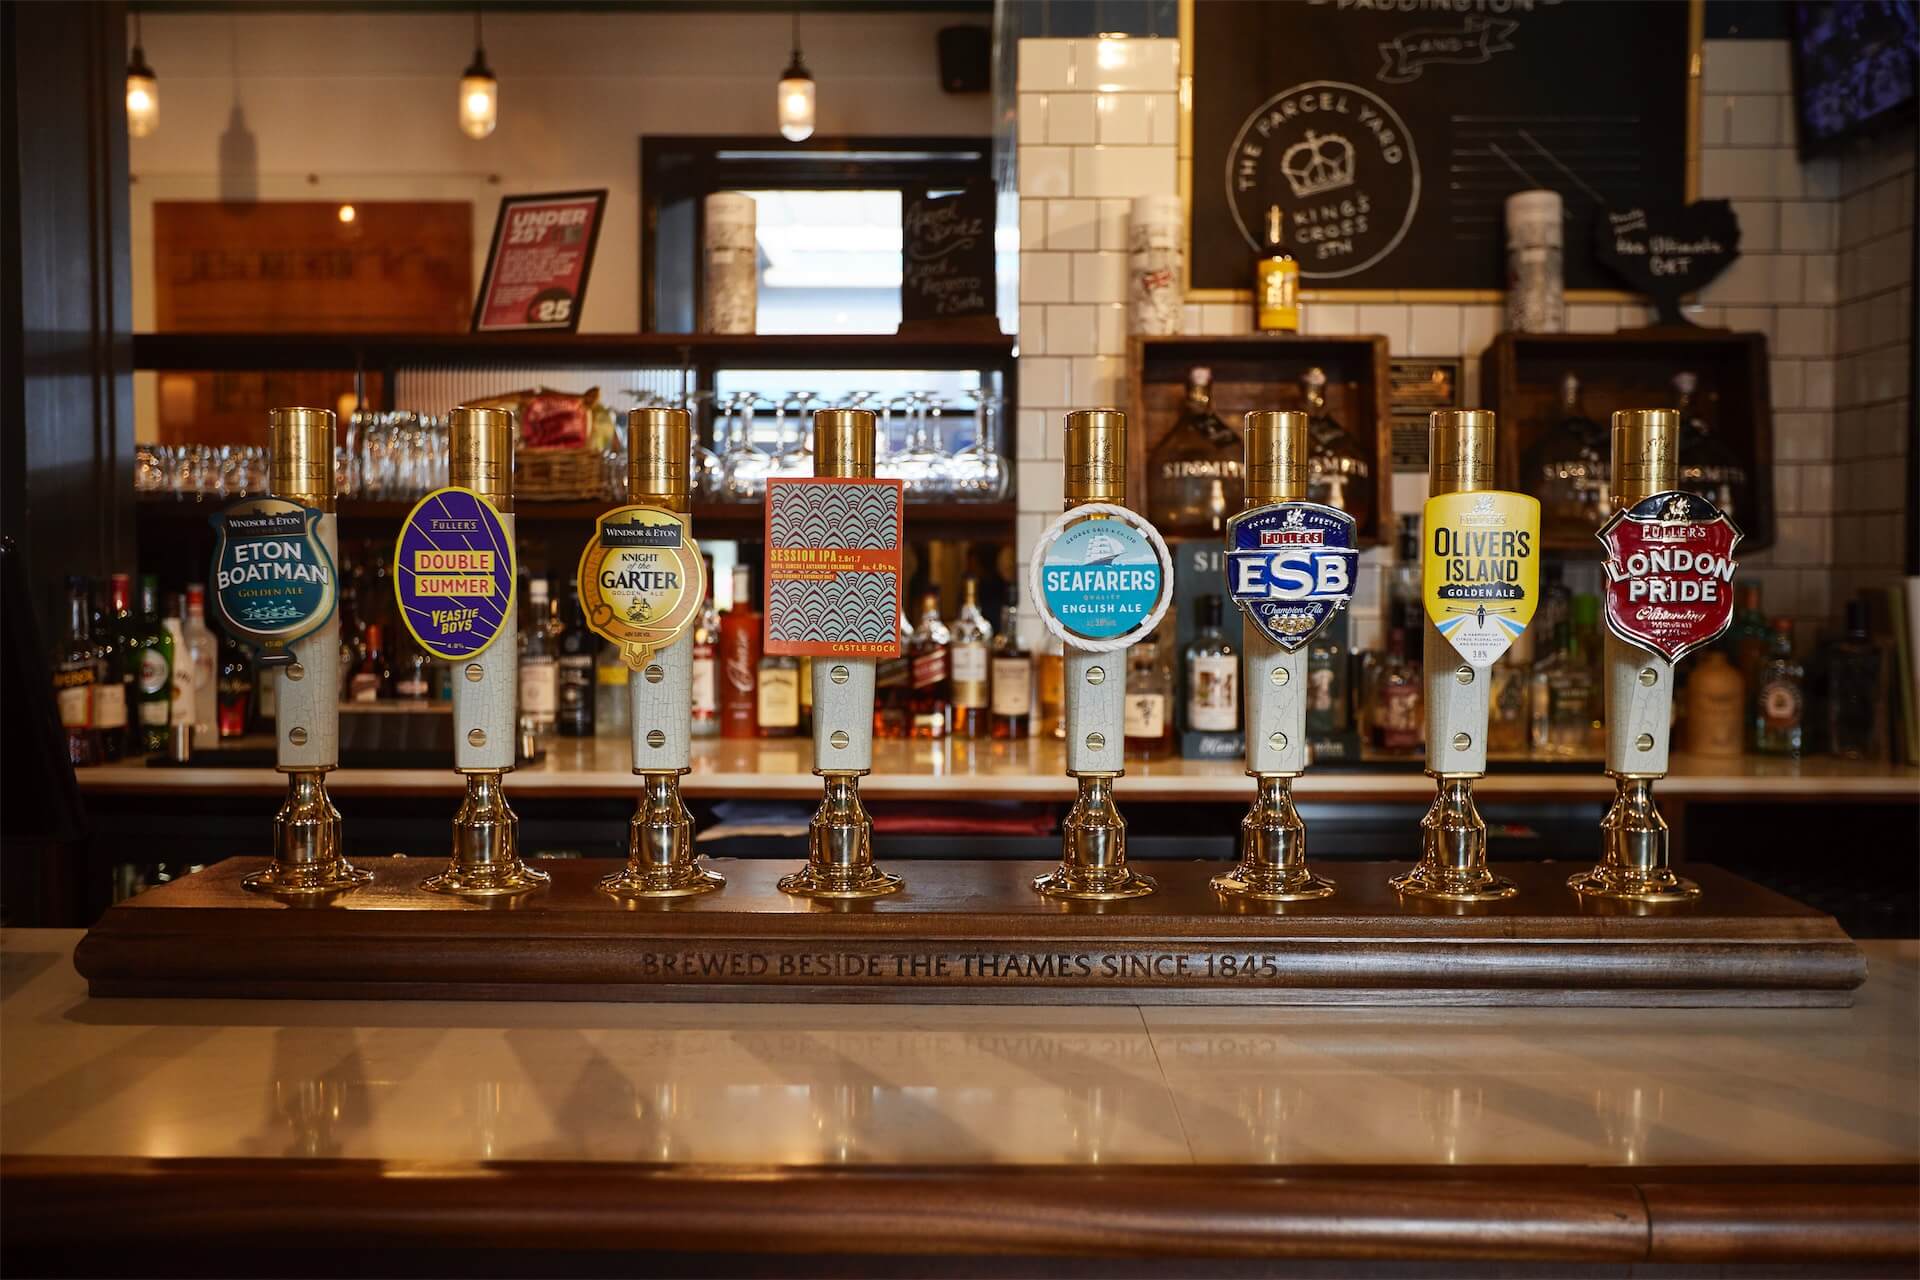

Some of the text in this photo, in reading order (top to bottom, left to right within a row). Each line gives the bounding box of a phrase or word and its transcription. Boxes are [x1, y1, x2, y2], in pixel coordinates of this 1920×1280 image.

[1238, 92, 1403, 191] THE PARCEL YARD
[511, 208, 588, 226] UNDER
[229, 518, 268, 529] WINDSOR
[276, 516, 301, 527] ETON
[605, 527, 645, 538] WINDSOR
[653, 527, 677, 537] ETON
[1433, 527, 1531, 558] OLIVER'S
[234, 541, 302, 564] ETON
[621, 552, 659, 563] KNIGHT
[770, 550, 816, 562] SESSION
[819, 550, 837, 563] IPA
[420, 554, 489, 570] DOUBLE
[1445, 559, 1519, 582] ISLAND
[1607, 550, 1737, 583] LONDON
[216, 562, 329, 590] BOATMAN
[601, 570, 681, 592] GARTER
[1047, 570, 1157, 592] SEAFARERS
[1236, 552, 1350, 599] ESB
[238, 586, 305, 598] GOLDEN ALE
[420, 578, 490, 593] SUMMER
[1447, 588, 1516, 598] GOLDEN ALE
[1629, 580, 1718, 602] PRIDE
[431, 607, 480, 628] YEASTIE
[1062, 603, 1143, 614] ENGLISH ALE
[1260, 603, 1304, 618] Champion
[440, 620, 473, 635] BOYS
[832, 644, 896, 653] CASTLE ROCK
[641, 952, 1278, 979] BREWED BESIDE THE THAMES SINCE 1845
